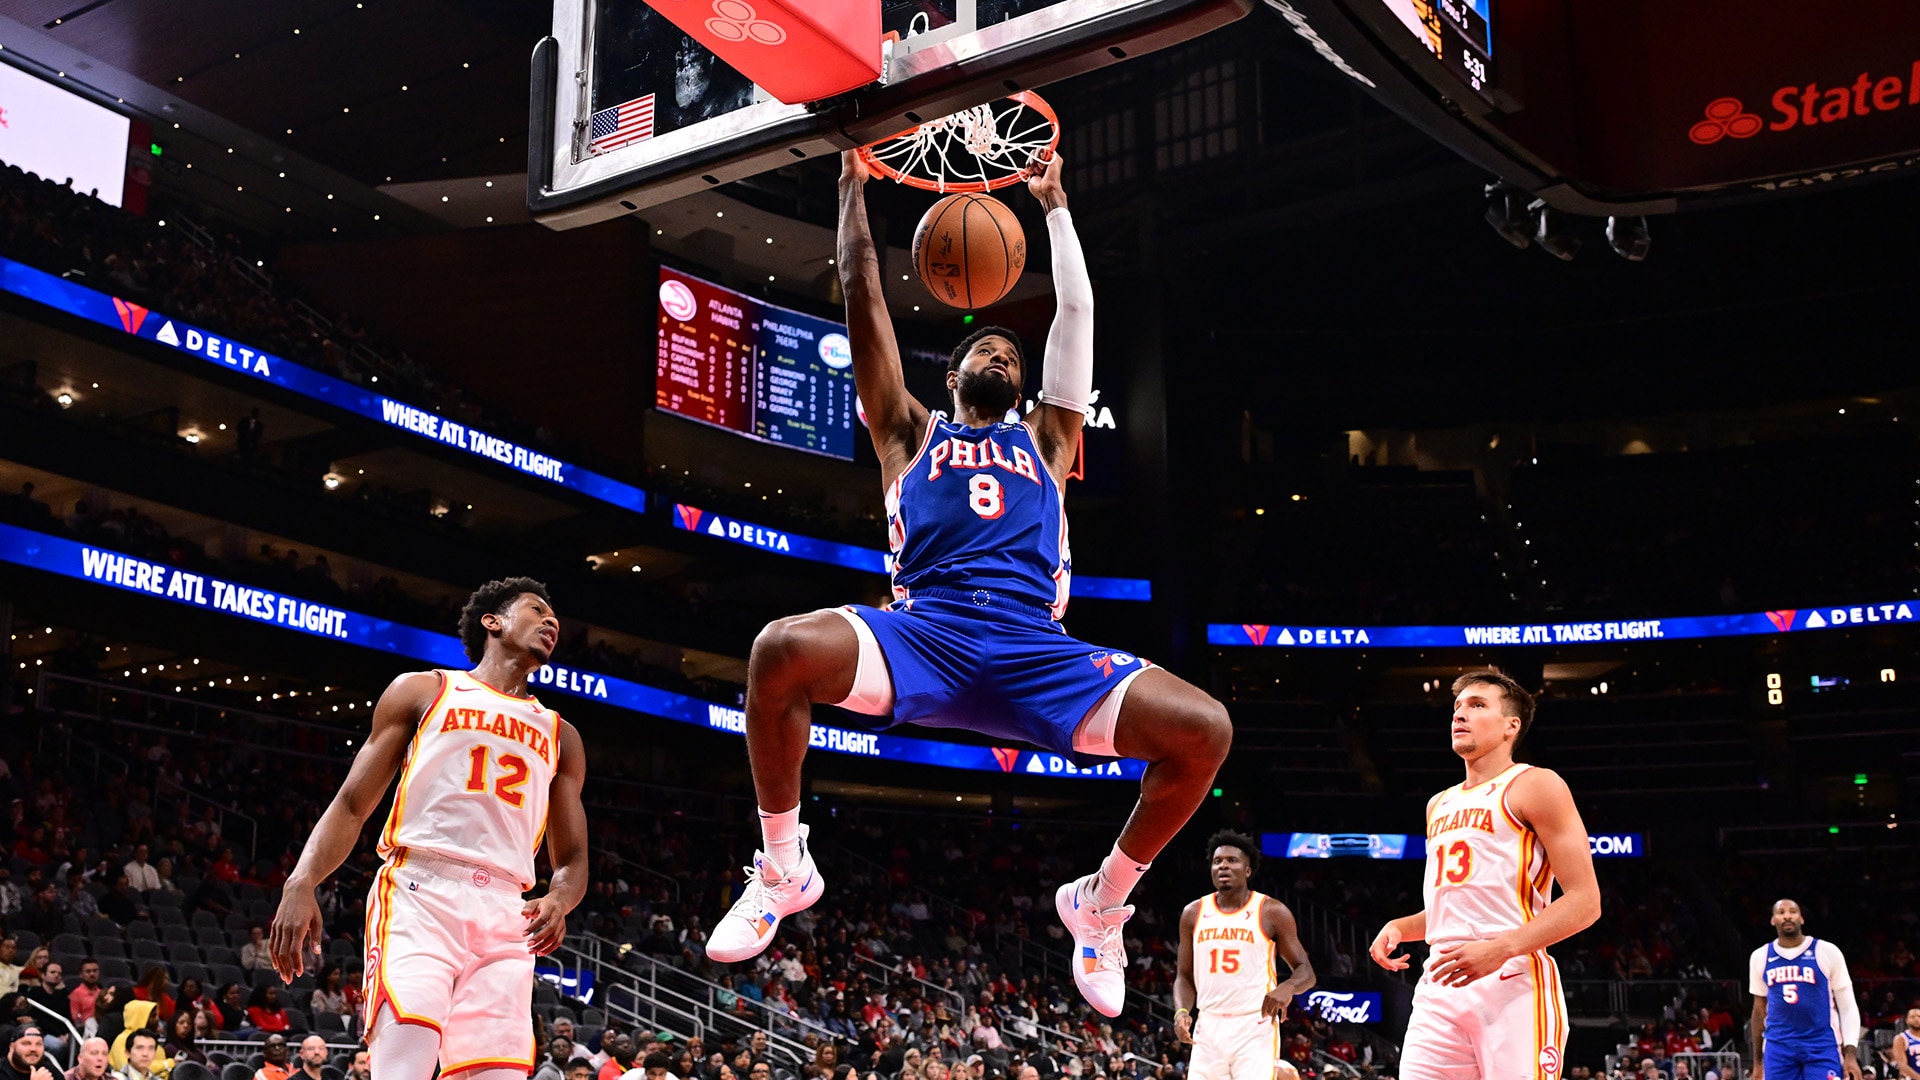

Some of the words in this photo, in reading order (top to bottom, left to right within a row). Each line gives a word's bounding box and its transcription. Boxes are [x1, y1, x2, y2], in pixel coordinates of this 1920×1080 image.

[708, 299, 743, 319] ATLANTA
[711, 312, 740, 330] HAWKS
[762, 319, 814, 341] PHILADELPHIA
[186, 329, 270, 377] DELTA
[382, 399, 439, 438] WHERE
[439, 420, 467, 449] ATL
[468, 430, 513, 464] TAKES
[514, 446, 564, 483] FLIGHT.
[927, 436, 1043, 486] PHILA
[968, 473, 1005, 520] 8
[729, 521, 790, 552] DELTA
[82, 548, 165, 594] WHERE
[167, 571, 207, 605] ATL
[211, 581, 275, 621] TAKES
[277, 598, 347, 638] FLIGHT.
[1830, 603, 1913, 625] DELTA
[1299, 629, 1370, 645] DELTA
[1464, 627, 1521, 645] WHERE
[1522, 626, 1552, 644] ATL
[1552, 624, 1601, 642] TAKES
[1604, 620, 1664, 640] FLIGHT.
[539, 664, 607, 699] DELTA
[708, 704, 746, 734] WHER
[440, 708, 550, 765] ATLANTA
[828, 728, 880, 755] FLIGHT.
[466, 743, 531, 809] 12
[1049, 756, 1122, 776] DEA
[1428, 807, 1495, 844] ATLANTA
[1434, 840, 1473, 888] 13
[1197, 927, 1255, 944] ATLANTA
[1209, 948, 1241, 975] 15
[1766, 965, 1816, 987] PHILA
[1783, 984, 1798, 1004] 5
